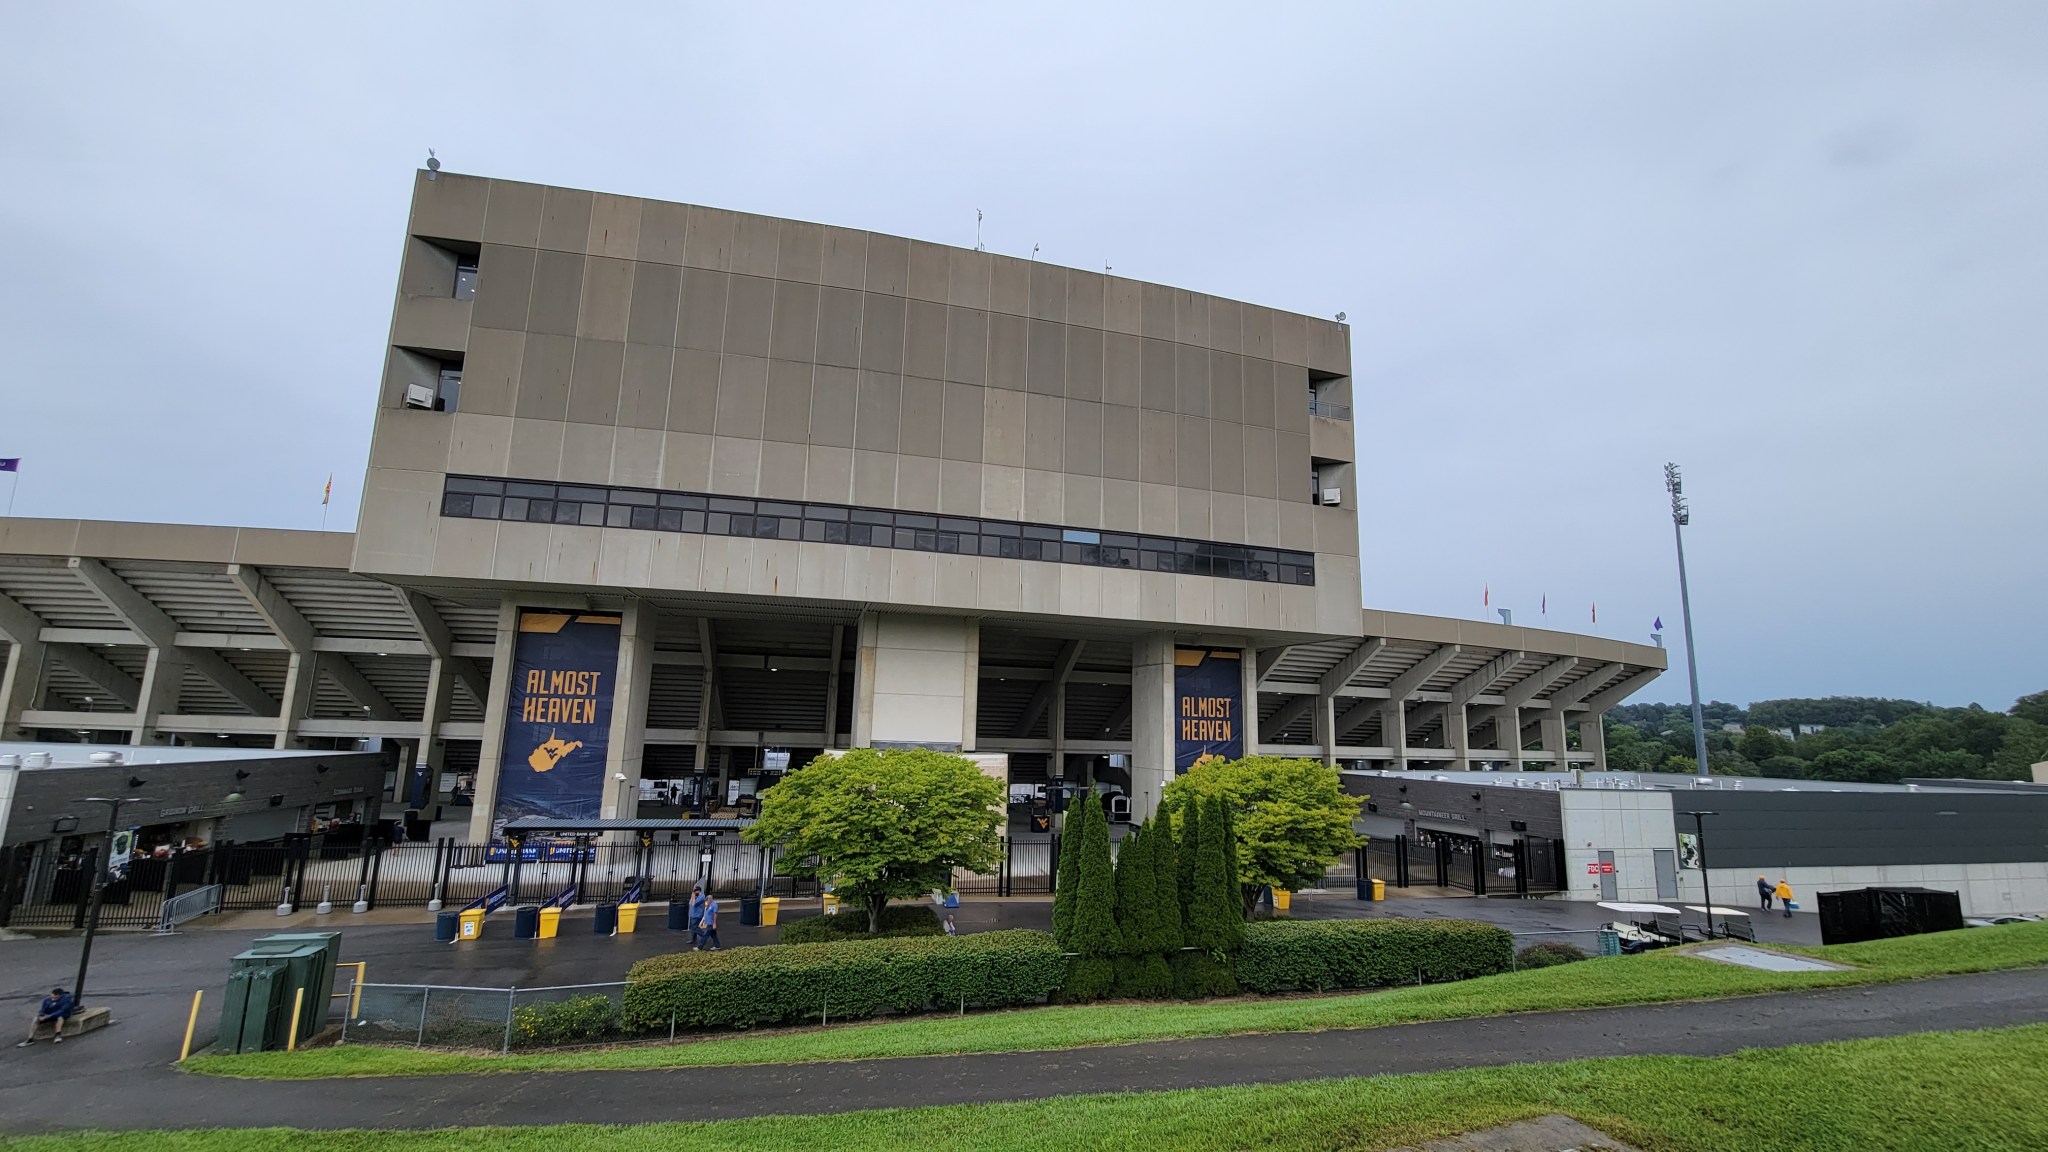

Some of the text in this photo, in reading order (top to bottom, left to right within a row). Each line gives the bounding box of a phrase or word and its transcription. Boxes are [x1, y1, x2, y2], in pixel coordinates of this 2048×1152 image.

[526, 669, 601, 696] ALMOST
[522, 697, 597, 724] HEAVEN
[1182, 696, 1232, 718] ALMOST
[1182, 719, 1231, 742] HEAVEN
[1587, 865, 1599, 873] FDC
